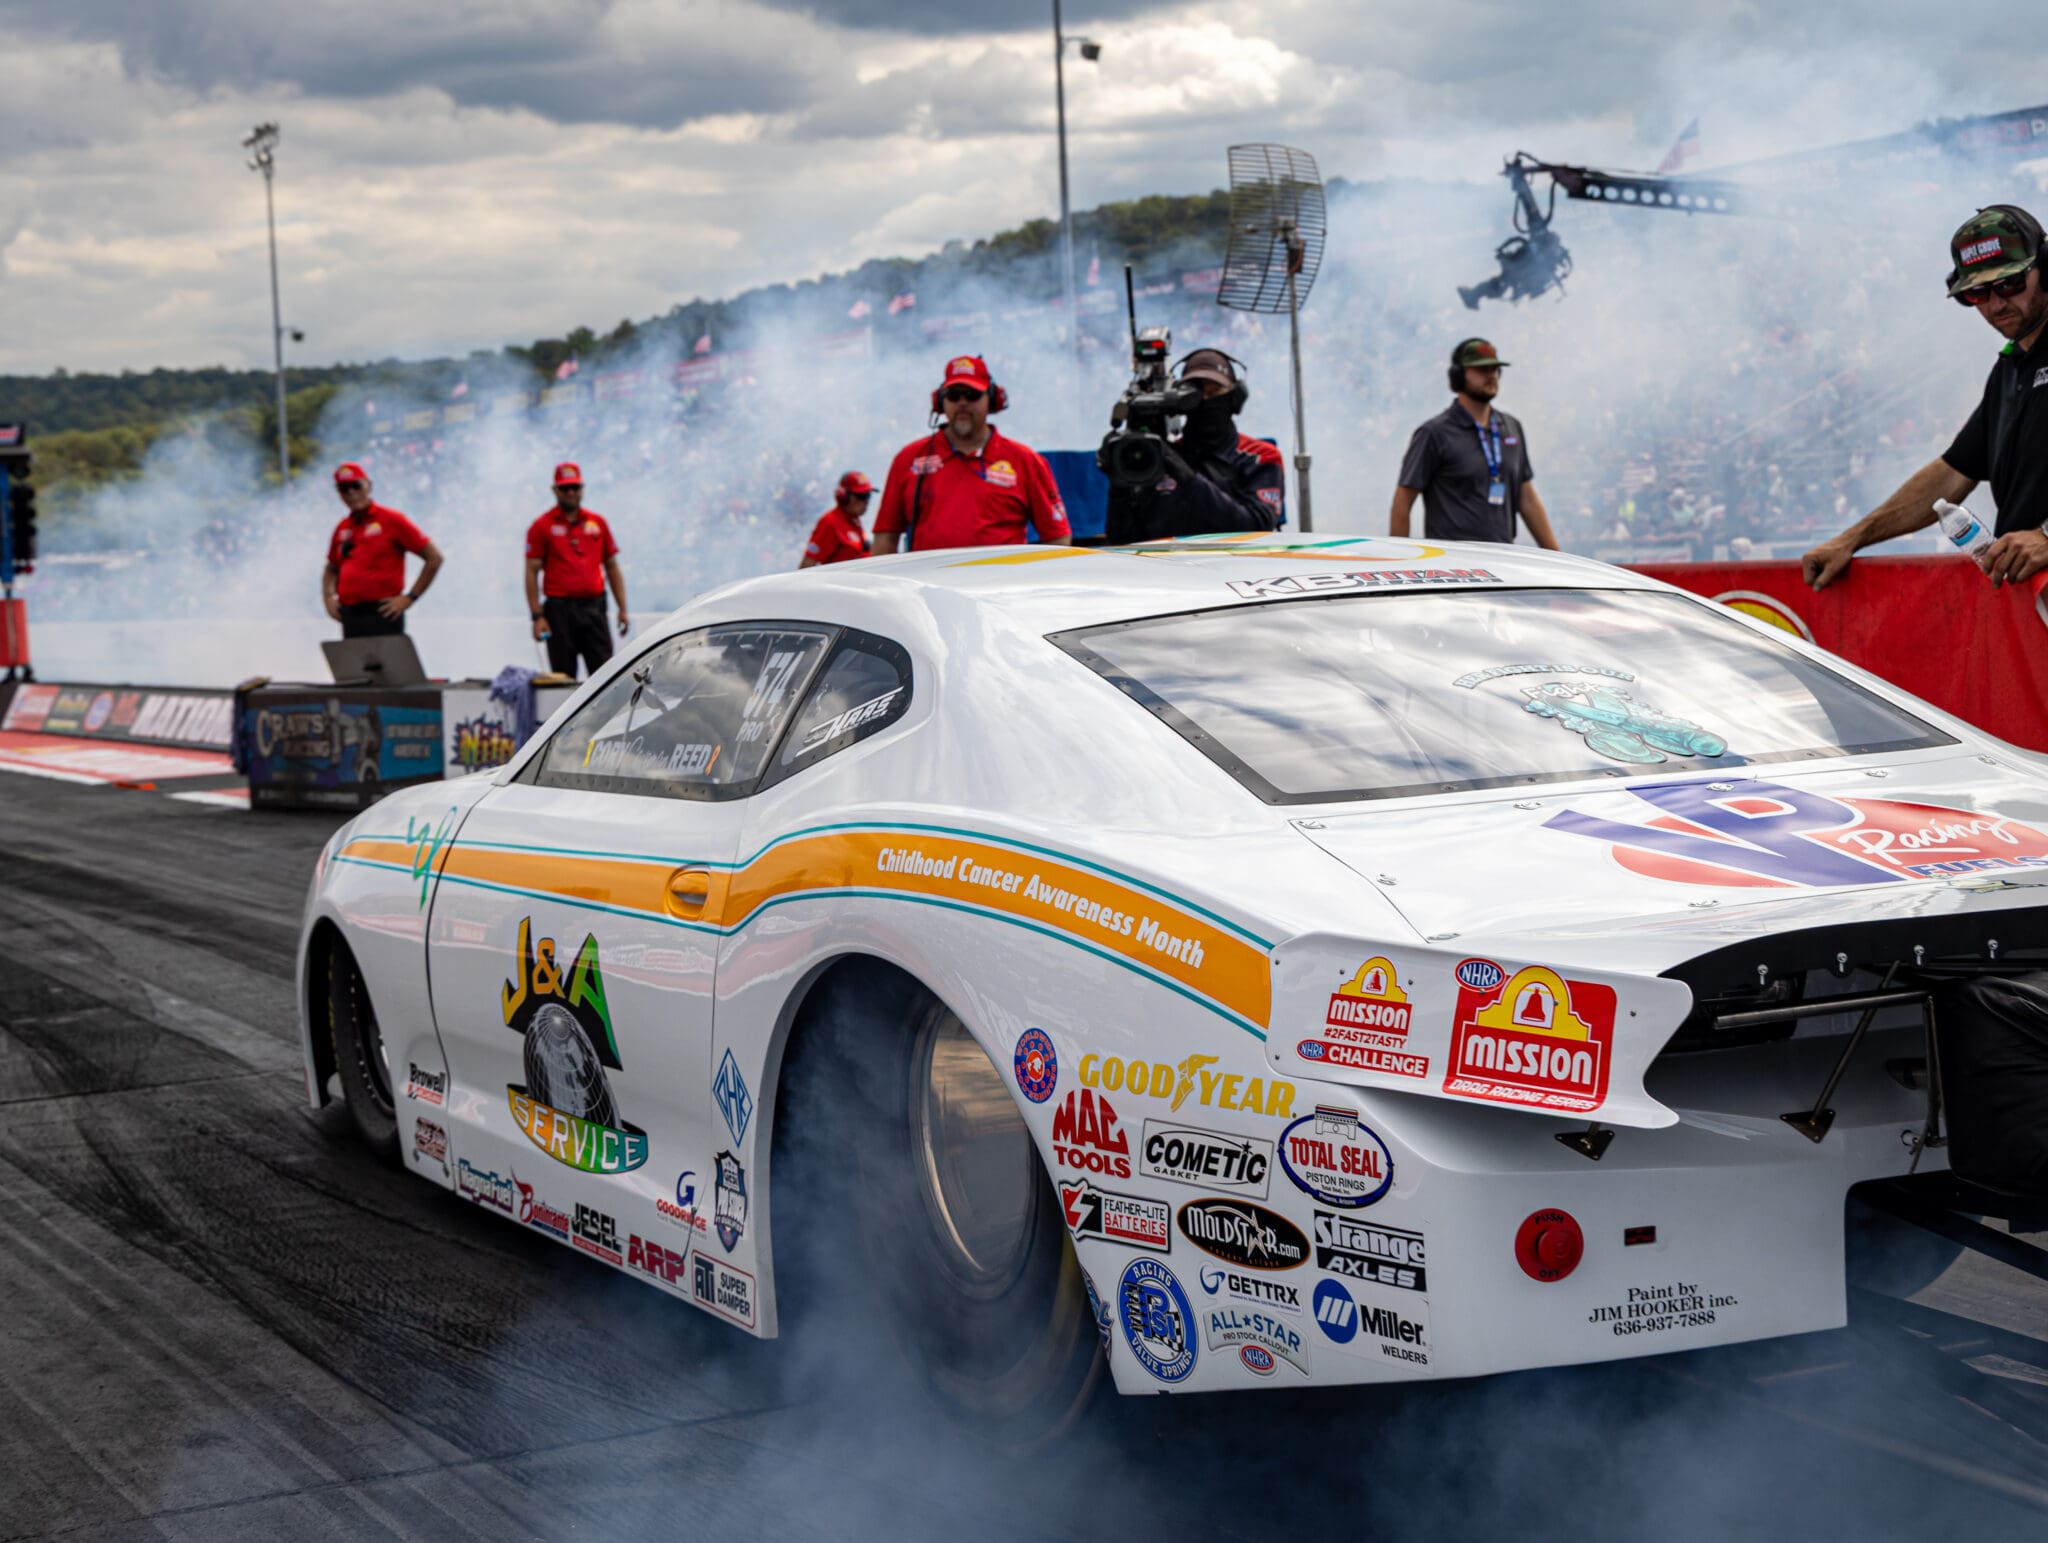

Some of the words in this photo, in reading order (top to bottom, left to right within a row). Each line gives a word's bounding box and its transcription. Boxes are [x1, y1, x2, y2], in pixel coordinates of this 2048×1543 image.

[1347, 568, 1494, 582] TITAN
[668, 744, 712, 774] REED
[1837, 818, 2020, 866] Racing
[1908, 856, 2048, 876] FUELS
[877, 848, 957, 879] Childhood
[957, 857, 1024, 894] Cancer
[1023, 873, 1134, 937] Awareness
[1136, 915, 1204, 969] Month
[1459, 962, 1502, 987] NHRA
[502, 916, 623, 1070] J&A
[1330, 998, 1409, 1031] MISSION
[1323, 1027, 1408, 1050] #2FAST2TASTY
[1299, 1041, 1326, 1059] NHRA
[1328, 1045, 1426, 1076] CHALLENGE
[1464, 1034, 1593, 1086] MISSION
[1448, 1079, 1491, 1095] DRAG
[1488, 1085, 1545, 1103] RACING
[1541, 1095, 1598, 1110] SERIES
[514, 1096, 641, 1170] SERVICE
[1052, 1088, 1130, 1156] MAC
[1053, 1144, 1131, 1179] TOOLS
[1145, 1133, 1268, 1185] COMETIC
[1153, 1166, 1200, 1181] GASKET
[1289, 1136, 1338, 1171] TOTAL
[1341, 1144, 1382, 1180] SEAL
[676, 1170, 696, 1207] G
[1306, 1171, 1337, 1187] PISTON
[1338, 1177, 1366, 1192] RINGS
[1104, 1198, 1166, 1221] FEATHER-LITE
[1104, 1212, 1167, 1236] BATTERIES
[1534, 1212, 1565, 1225] PUSH
[571, 1202, 623, 1254] JESEL
[1314, 1212, 1426, 1266] Strange
[628, 1233, 685, 1285] ARP
[1132, 1262, 1173, 1287] RACING
[1326, 1255, 1417, 1288] AXLES
[720, 1272, 747, 1298] SUPER
[1228, 1273, 1301, 1307] GETTRX
[1627, 1286, 1674, 1303] Paint
[1677, 1282, 1699, 1300] by
[717, 1288, 750, 1318] DAMPER
[1588, 1305, 1622, 1324] JIM
[1627, 1295, 1705, 1319] HOOKER
[1708, 1293, 1739, 1308] inc.
[1360, 1304, 1424, 1347] Miller
[1612, 1310, 1716, 1337] 636-937-7888
[1131, 1336, 1159, 1373] VALVE
[1160, 1347, 1194, 1378] SPRINGS
[1223, 1332, 1237, 1342] PRO
[1236, 1331, 1258, 1343] STOCK
[1258, 1335, 1290, 1355] CALLOUT
[1243, 1348, 1272, 1369] NHRA
[1381, 1344, 1429, 1366] WELDERS
